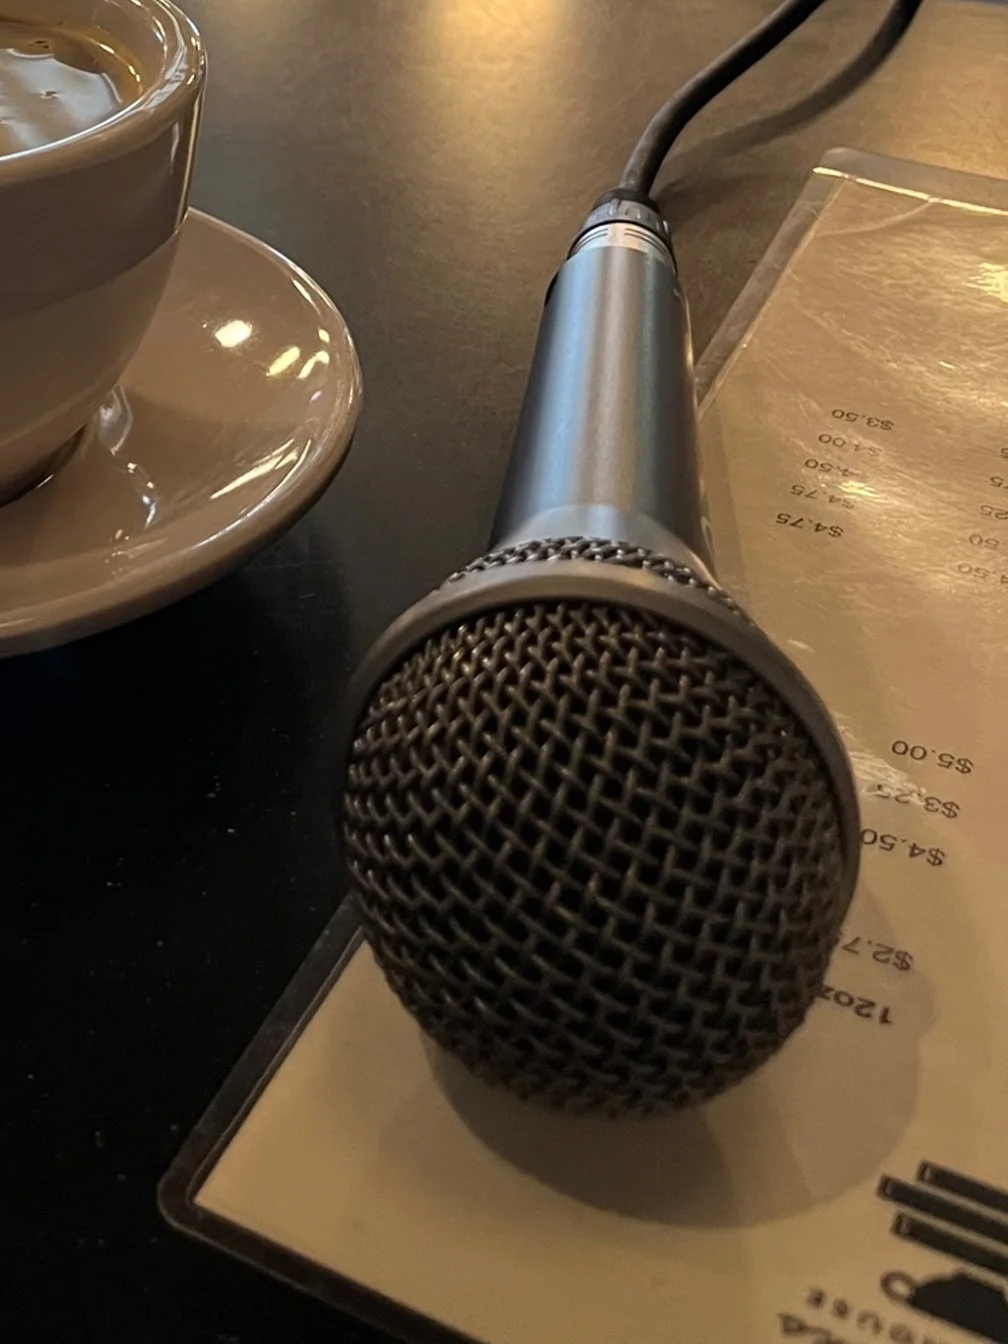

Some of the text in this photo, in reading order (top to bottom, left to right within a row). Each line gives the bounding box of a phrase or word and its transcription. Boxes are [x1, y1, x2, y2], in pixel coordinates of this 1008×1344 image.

[831, 409, 894, 431] $3.50
[775, 513, 844, 538] $4.75
[891, 740, 974, 775] $5.00
[859, 828, 945, 867] $4.50
[837, 932, 914, 971] $2.7
